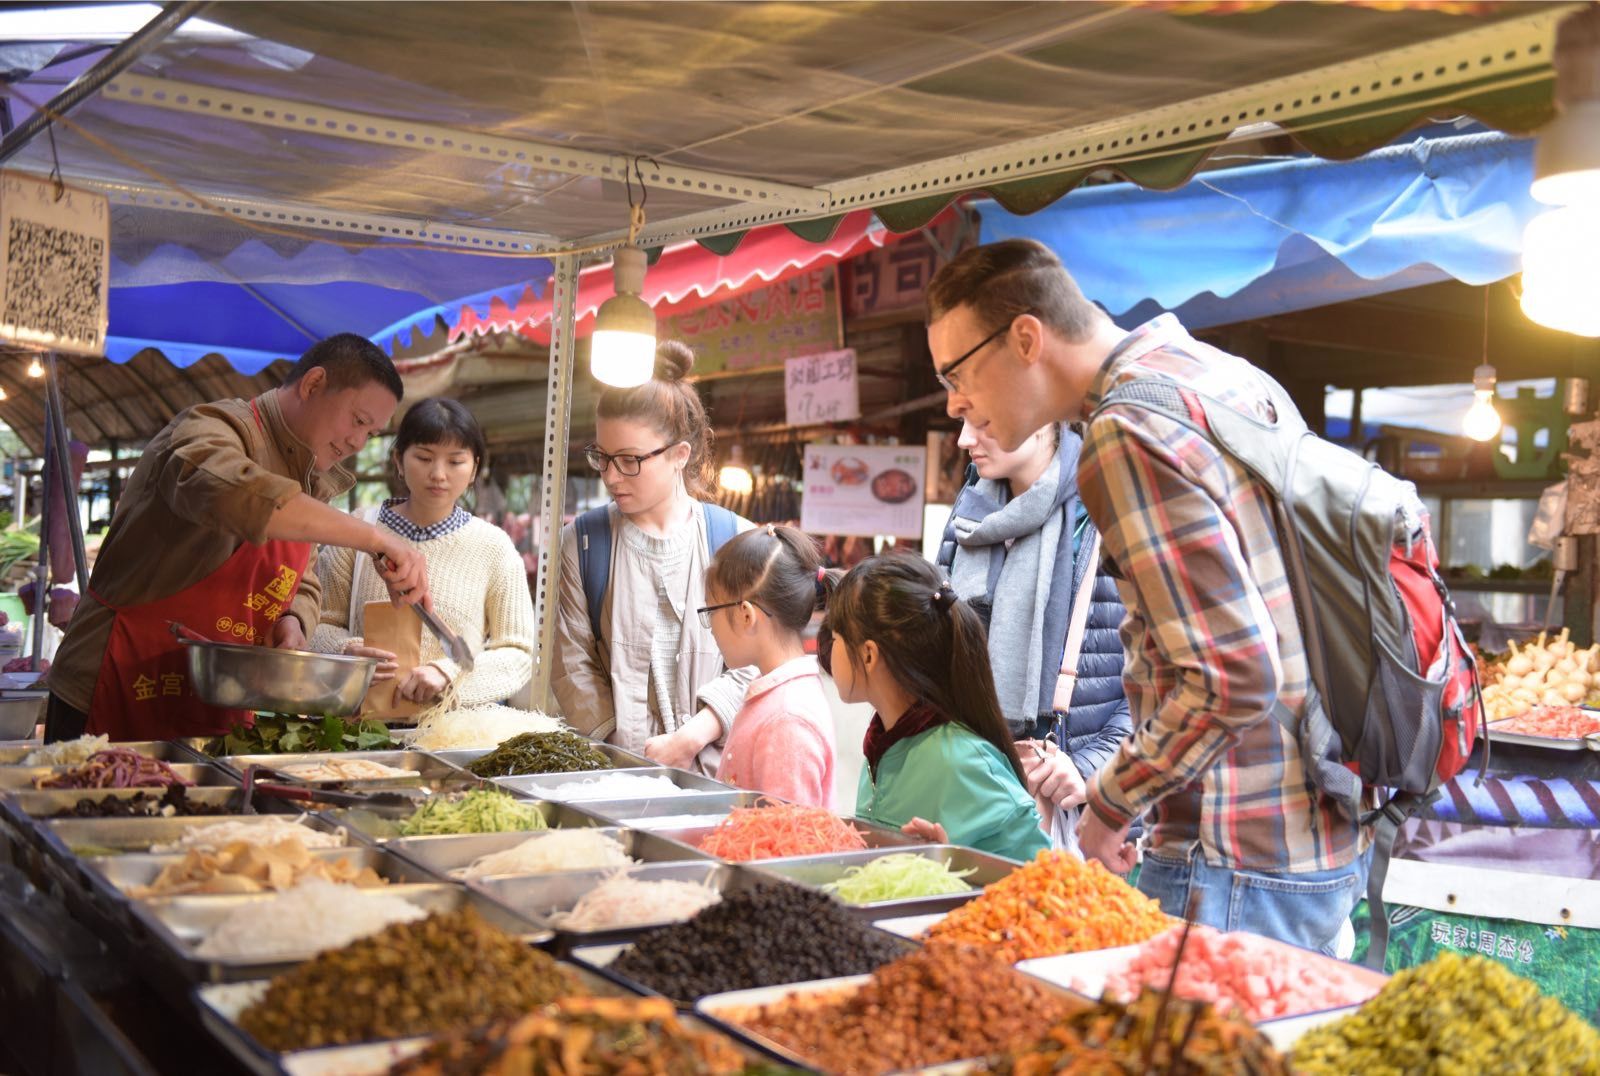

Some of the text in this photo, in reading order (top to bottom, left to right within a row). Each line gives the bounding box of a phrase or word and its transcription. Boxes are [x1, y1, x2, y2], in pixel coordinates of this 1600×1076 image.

[132, 672, 193, 701] 金宫
[1431, 920, 1535, 964] 玩家:周杰伦
